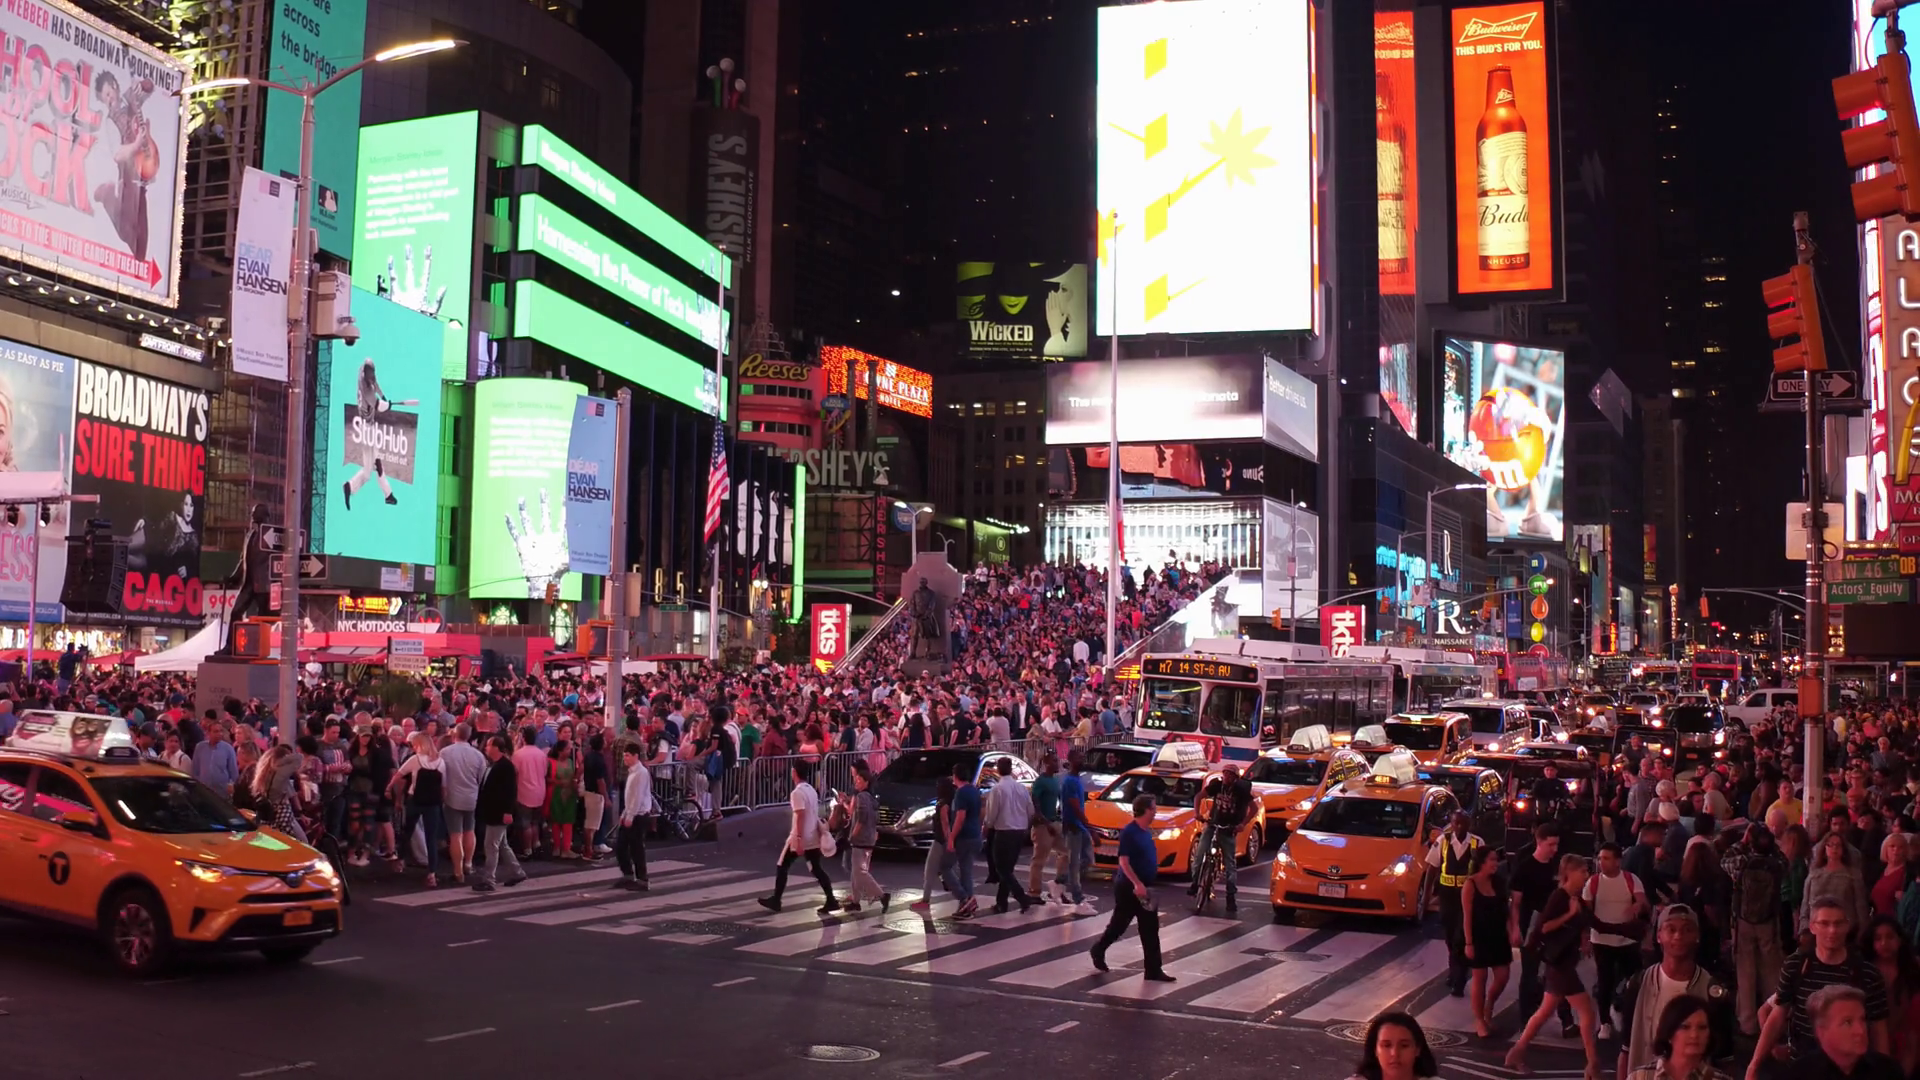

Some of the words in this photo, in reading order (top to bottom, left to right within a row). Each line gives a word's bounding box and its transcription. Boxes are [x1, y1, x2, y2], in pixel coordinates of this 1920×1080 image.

[283, 3, 320, 37] across
[1465, 22, 1529, 36] Budweiser
[7, 0, 49, 31] WEBBER
[51, 14, 72, 42] HAS
[74, 25, 129, 70] BROADWAY
[281, 30, 300, 57] the
[1455, 46, 1475, 56] THIS
[1476, 44, 1502, 55] BUD'S
[1504, 42, 1521, 52] FOR
[21, 219, 32, 238] TO
[34, 224, 50, 245] THE
[52, 230, 83, 257] WINTER
[116, 252, 149, 279] THEATRE
[537, 214, 601, 278] Harnessing
[602, 250, 619, 283] the
[621, 263, 651, 300] Power
[652, 284, 663, 306] of
[238, 257, 270, 277] EVAN
[237, 271, 287, 296] HANSEN
[5, 349, 16, 359] AS
[17, 352, 38, 367] EASY
[39, 359, 50, 370] AS
[52, 361, 65, 373] PIE
[739, 353, 811, 381] Reese's
[898, 381, 929, 401] PLAZA
[1203, 391, 1239, 402] onata
[1782, 381, 1804, 391] ONE
[79, 362, 209, 442] BROADWAY'S
[879, 393, 901, 407] HOTEL
[352, 416, 408, 455] StubHub
[75, 418, 137, 483] SURE
[141, 432, 205, 496] THING
[568, 472, 596, 487] EVAN
[568, 485, 611, 501] HANSEN
[1845, 564, 1857, 579] W
[1864, 562, 1882, 578] 46
[1831, 583, 1866, 595] Actors'
[1870, 583, 1903, 595] Equity
[338, 620, 356, 632] NYC
[357, 620, 405, 632] HOTDOGS
[819, 608, 842, 655] tkts
[1332, 610, 1357, 658] tkts
[1159, 660, 1172, 673] M7
[1179, 663, 1189, 673] 14
[1193, 663, 1215, 674] ST-6
[1218, 665, 1231, 677] AV
